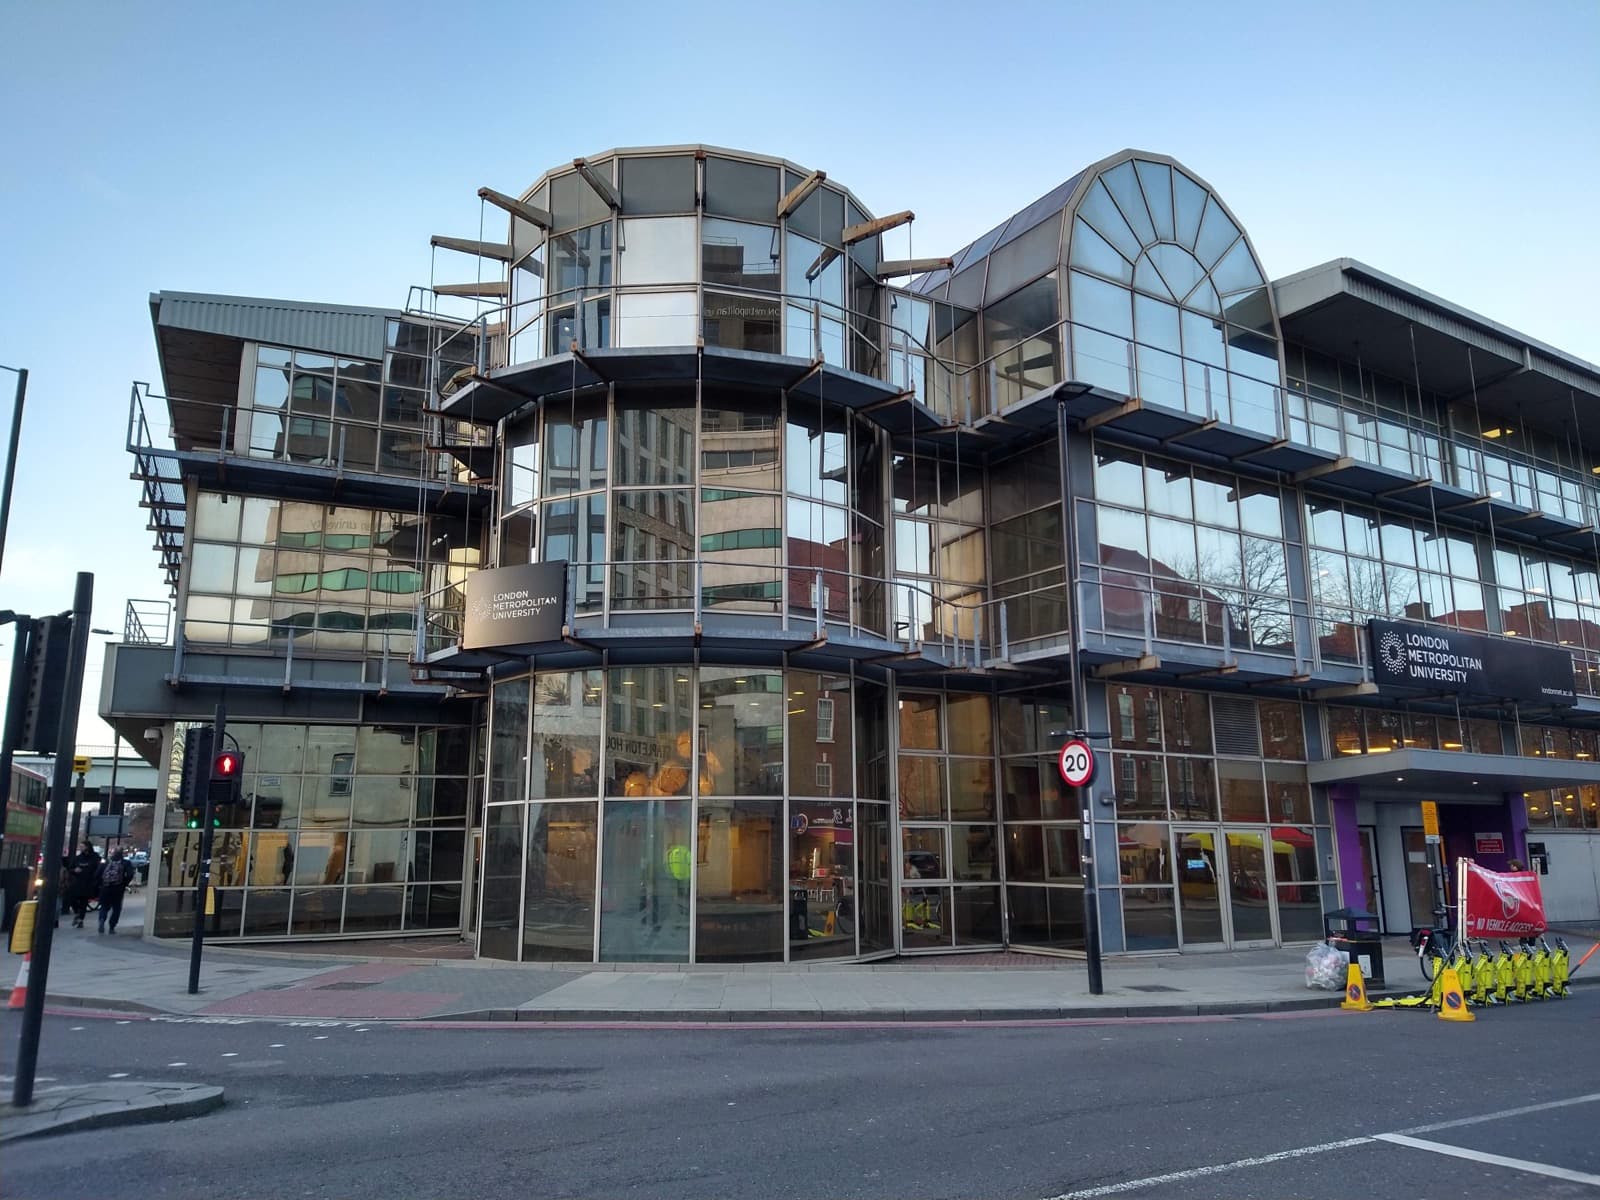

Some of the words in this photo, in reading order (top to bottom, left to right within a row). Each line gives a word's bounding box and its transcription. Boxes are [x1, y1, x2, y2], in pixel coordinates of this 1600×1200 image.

[493, 590, 529, 602] LONDON
[493, 597, 556, 610] METROPOLITAN
[492, 608, 541, 619] UNIVERSITY
[1406, 633, 1449, 651] LONDON
[1408, 649, 1482, 670] METROPOLITAN
[1410, 665, 1467, 683] UNIVERSITY
[1066, 754, 1087, 772] 20
[1477, 918, 1485, 930] NO
[1487, 919, 1510, 931] VEHICLE
